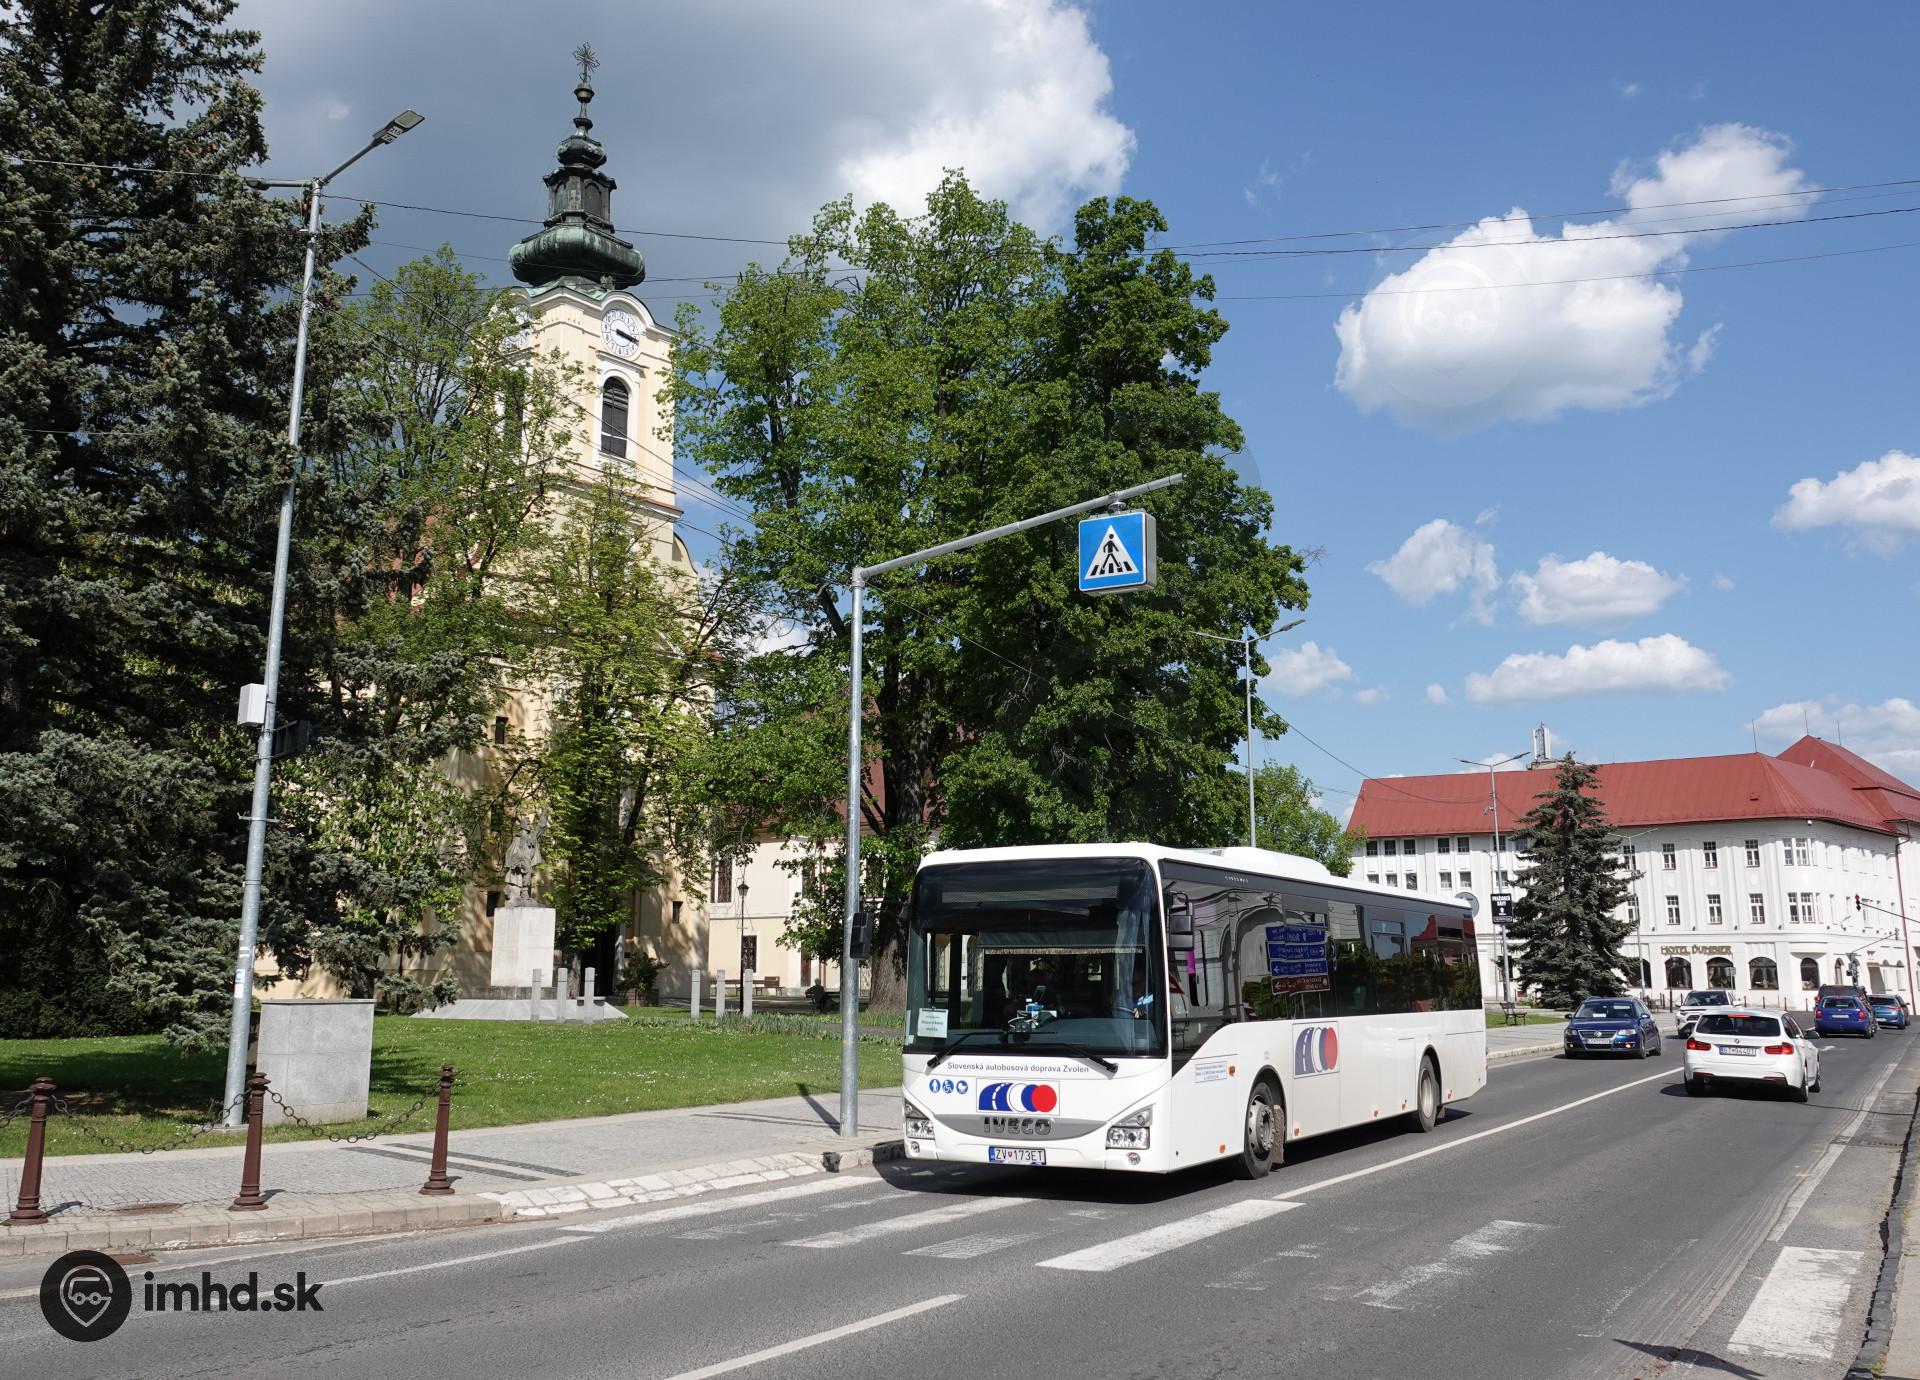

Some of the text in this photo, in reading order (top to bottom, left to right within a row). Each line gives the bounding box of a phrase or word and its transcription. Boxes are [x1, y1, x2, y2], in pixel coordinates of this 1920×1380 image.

[1661, 945, 1691, 957] HOTEL
[947, 1062, 1090, 1074] Slovenská autobusová doprava Zvolen
[983, 1117, 1052, 1136] IVECO
